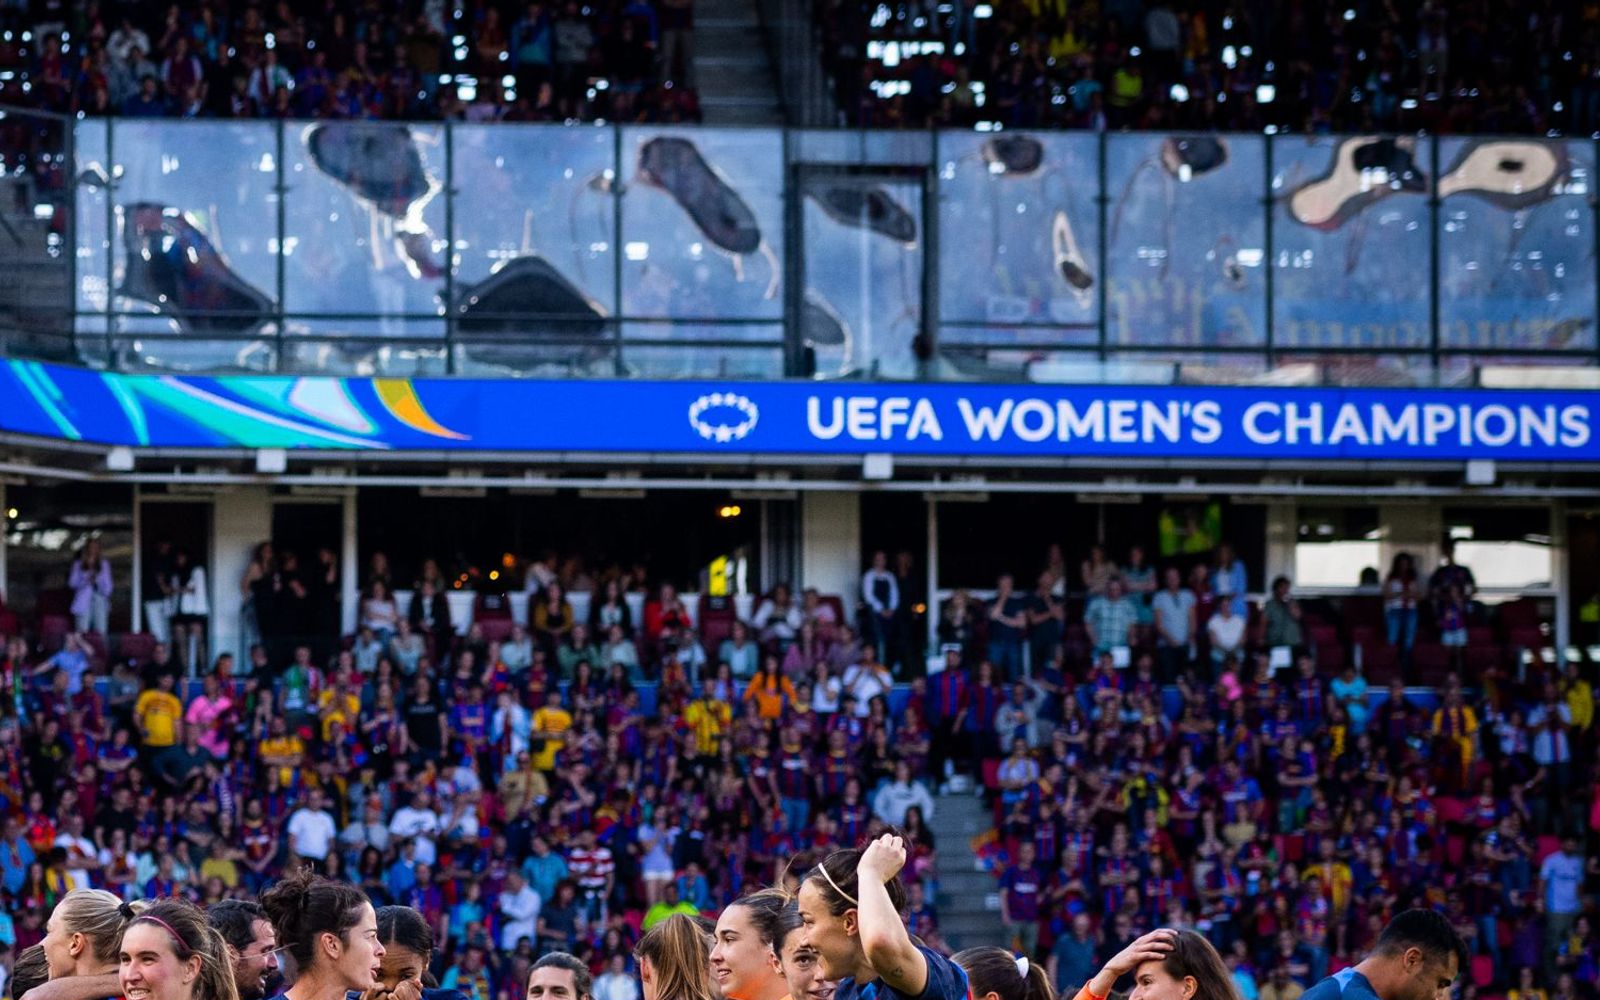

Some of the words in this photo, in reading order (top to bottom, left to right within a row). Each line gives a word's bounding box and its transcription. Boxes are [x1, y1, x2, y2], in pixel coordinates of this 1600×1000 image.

[806, 396, 943, 441] UEFA
[957, 398, 1222, 444] WOMEN'S
[1241, 402, 1591, 448] CHAMPIONS
